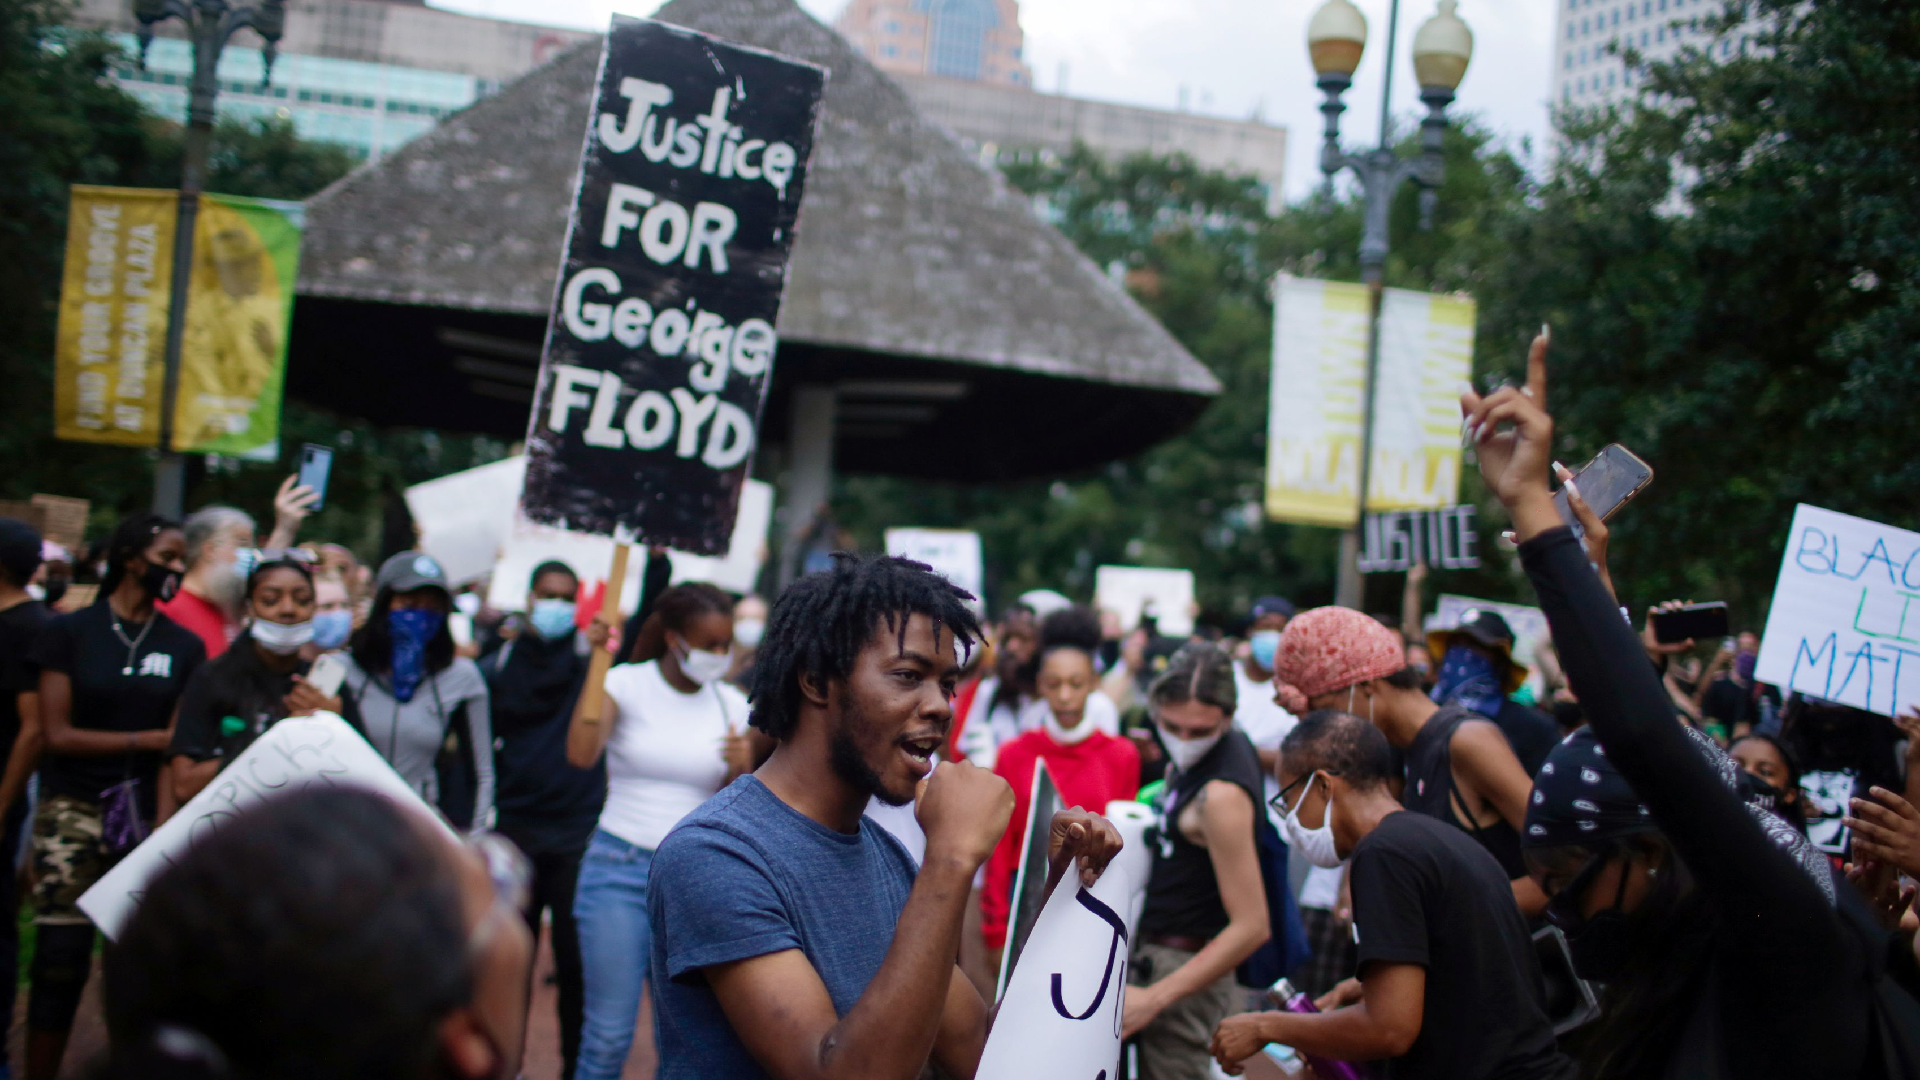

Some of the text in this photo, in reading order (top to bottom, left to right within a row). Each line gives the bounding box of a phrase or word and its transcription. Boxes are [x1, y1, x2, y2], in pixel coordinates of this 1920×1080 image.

[599, 76, 797, 187] Justice
[601, 182, 738, 274] FOR
[78, 302, 111, 365] YOUR
[114, 223, 158, 431] AT DUNCAN PLAZA
[562, 267, 777, 392] George
[548, 364, 755, 469] FLOYD
[1370, 448, 1460, 507] NOLA
[1357, 504, 1481, 573] JUSTICE
